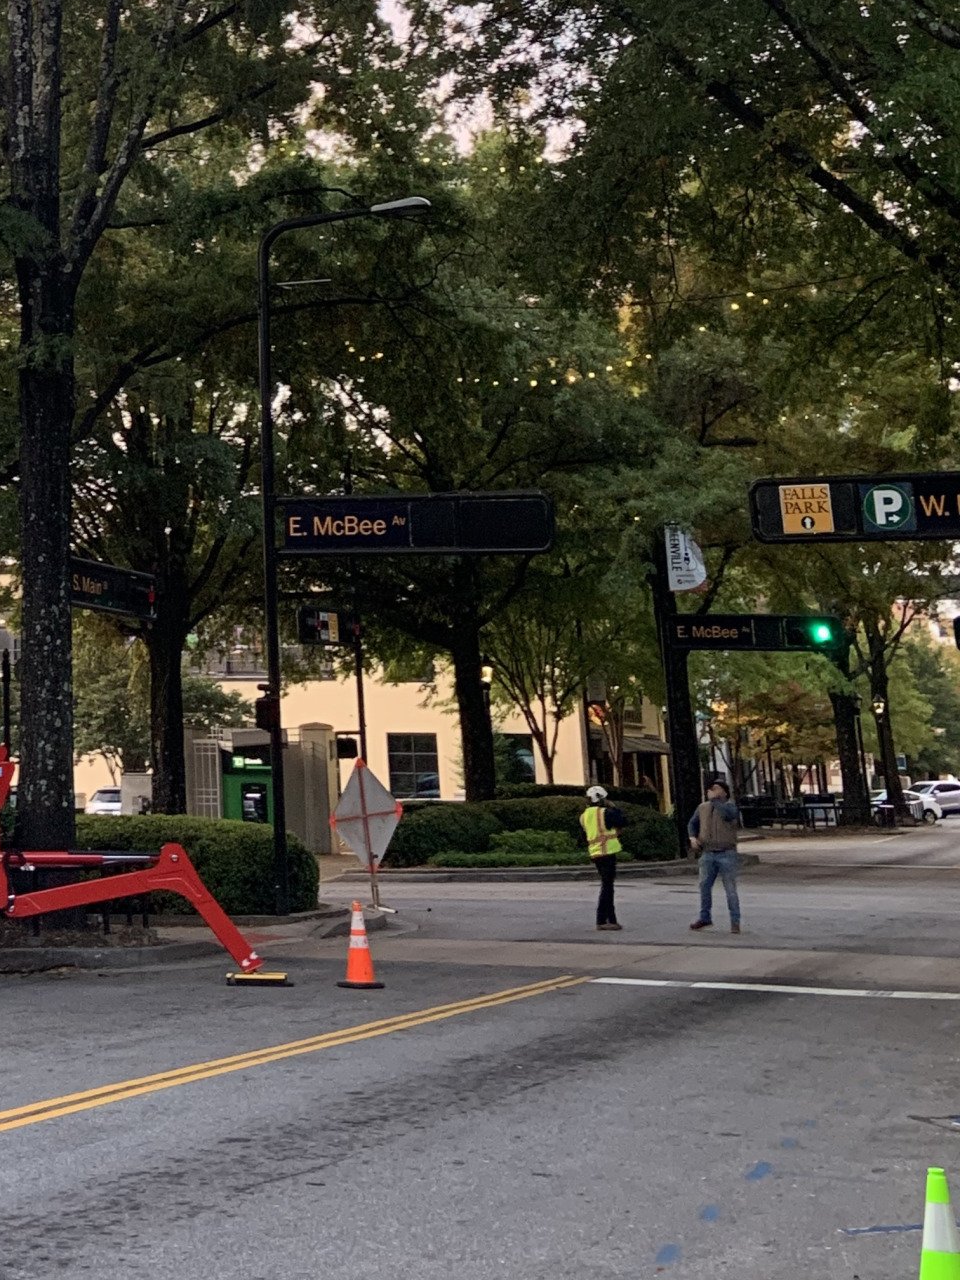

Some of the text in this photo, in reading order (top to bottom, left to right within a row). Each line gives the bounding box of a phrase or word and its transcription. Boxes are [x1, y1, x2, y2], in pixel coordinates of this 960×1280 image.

[783, 488, 828, 500] FALLS
[784, 501, 830, 514] PARK
[873, 489, 903, 525] P
[920, 495, 950, 517] W.
[289, 515, 406, 536] E. McBee Av
[669, 527, 682, 571] EENVILLE
[82, 576, 102, 595] Main
[676, 625, 688, 638] E.
[692, 625, 738, 638] McBee
